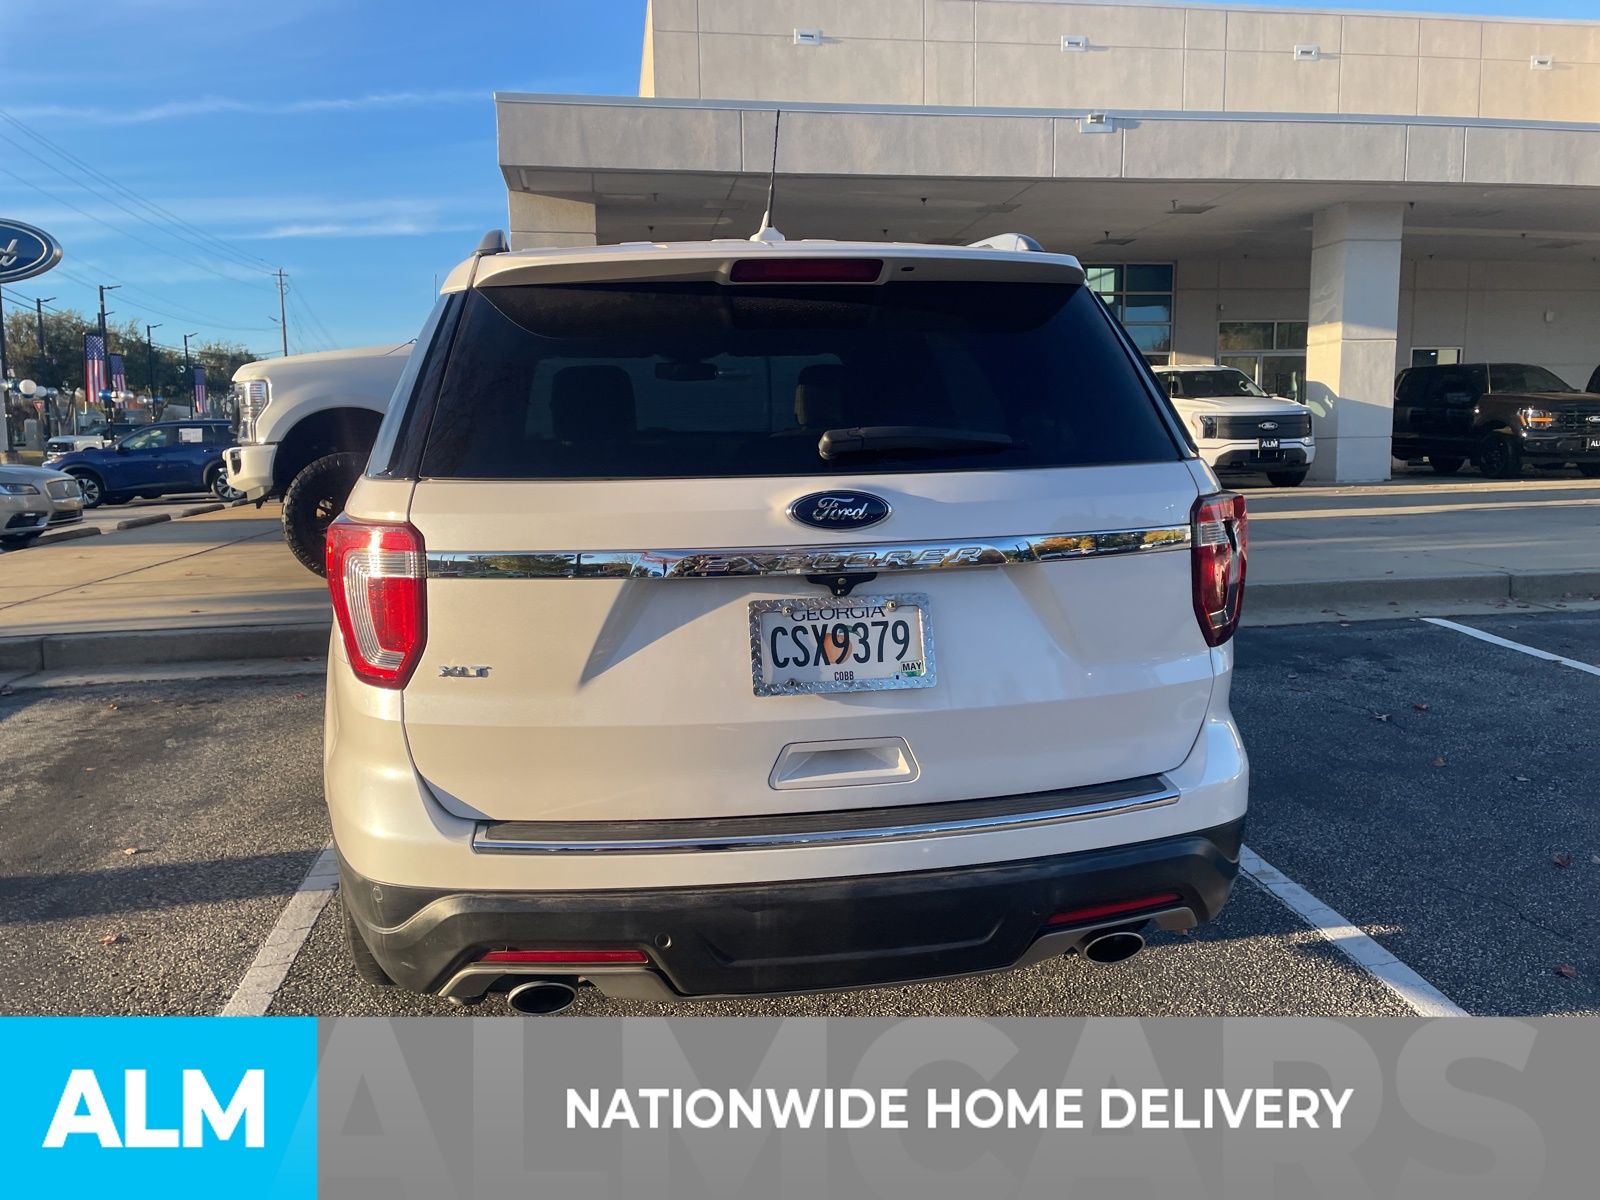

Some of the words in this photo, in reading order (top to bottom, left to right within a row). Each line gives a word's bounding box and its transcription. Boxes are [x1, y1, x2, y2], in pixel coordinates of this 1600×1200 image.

[812, 497, 869, 520] Ford
[696, 547, 982, 574] EXPLORER
[791, 606, 886, 622] GEORGIA
[770, 620, 910, 668] CSX9379
[438, 666, 493, 678] XLT
[902, 662, 922, 672] MAY
[834, 671, 854, 681] COBB
